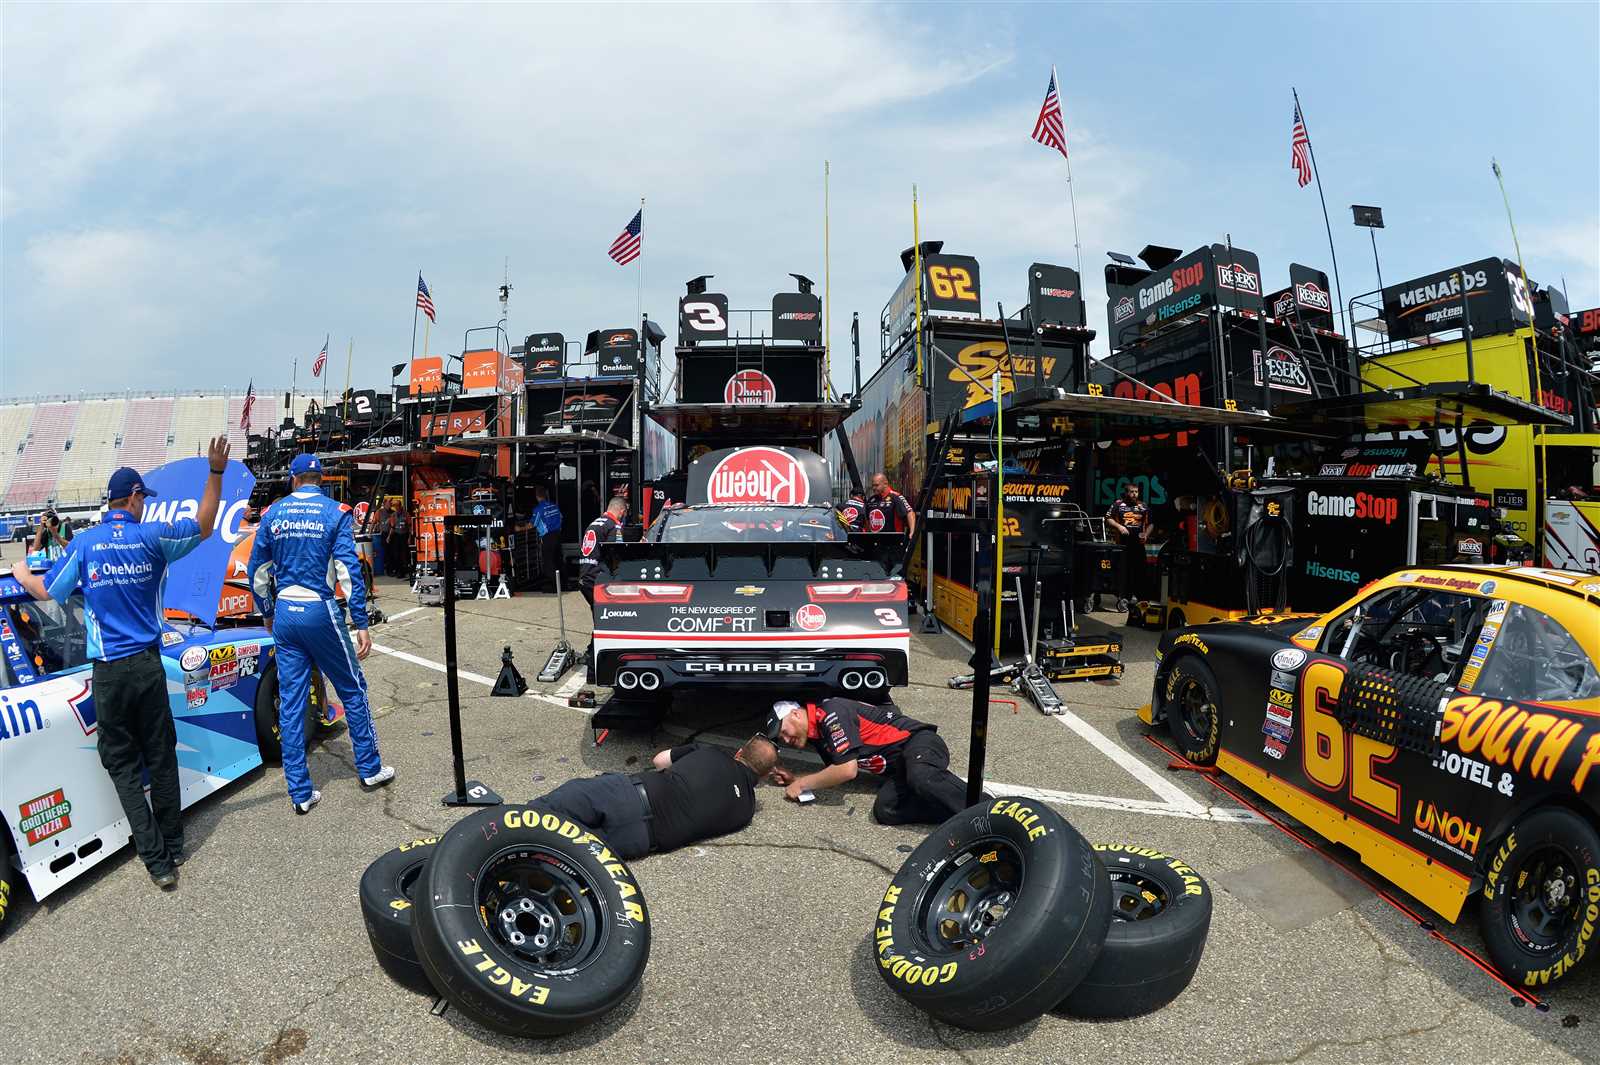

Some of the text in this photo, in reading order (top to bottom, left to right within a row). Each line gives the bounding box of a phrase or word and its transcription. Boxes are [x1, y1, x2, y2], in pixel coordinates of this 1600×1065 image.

[929, 266, 977, 300] 62
[1139, 262, 1204, 309] GameStop
[1400, 271, 1487, 308] MENARDS
[683, 302, 727, 331] 3
[1158, 293, 1201, 320] Hisense
[530, 345, 560, 353] OneMain
[412, 374, 441, 383] ARRIS
[465, 369, 496, 377] ARRIS
[602, 364, 633, 372] OneMain
[1088, 383, 1103, 397] 62
[355, 396, 372, 414] 2
[1225, 400, 1237, 411] 62
[653, 489, 664, 499] 33
[1002, 482, 1070, 497] SOUTH POINT
[723, 505, 775, 513] DILLON
[1307, 490, 1398, 524] GameStop
[102, 561, 153, 575] OneMain
[1305, 560, 1361, 584] Hisense
[670, 606, 757, 614] THE NEW DEGREE OF
[874, 607, 902, 626] 3
[211, 661, 239, 677] ARP
[685, 662, 815, 672] CAMARO
[1440, 695, 1584, 781] SOUTH
[1263, 746, 1282, 760] MSD
[1497, 773, 1515, 797] &
[29, 794, 56, 815] HUNT
[22, 803, 71, 832] BROTHERS
[990, 799, 1048, 842] EAGLE
[1414, 799, 1482, 856] UNOH
[34, 820, 64, 840] PIZZA
[503, 809, 644, 924] GOODYEAR
[1483, 832, 1518, 900] EAGLE
[876, 884, 959, 987] GOODYEAR
[1524, 868, 1600, 987] GOODYEAR
[457, 938, 551, 1005] EAGLE
